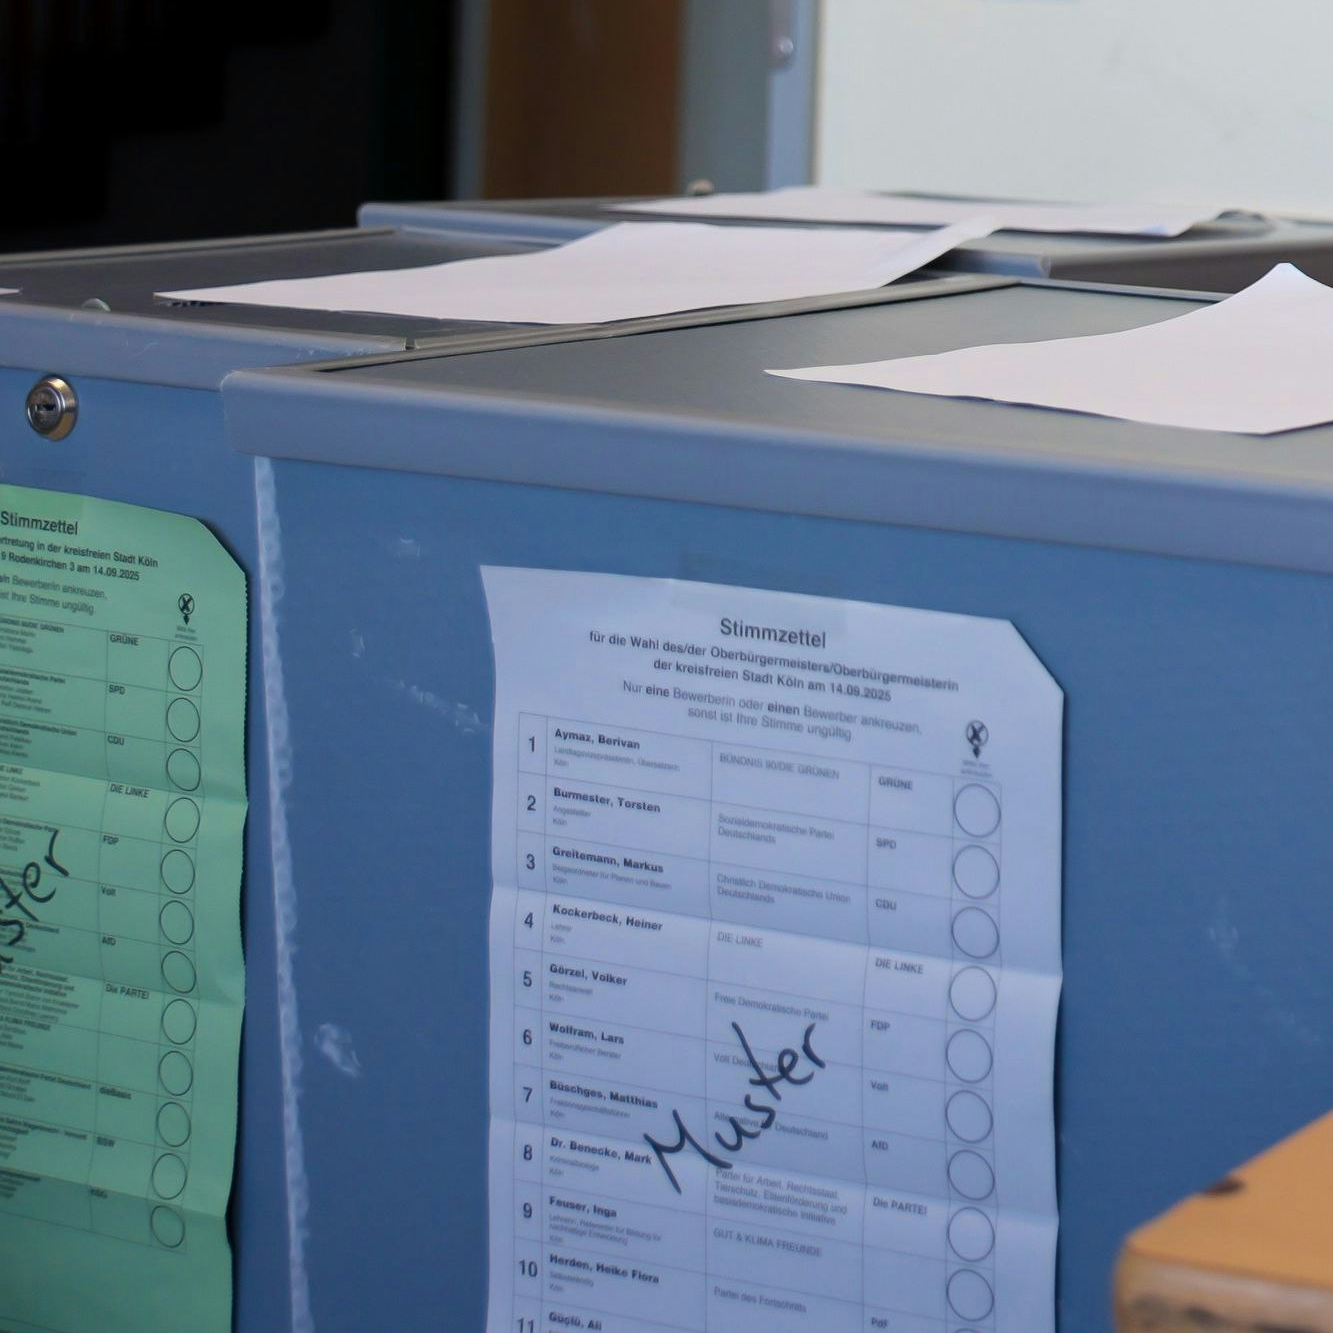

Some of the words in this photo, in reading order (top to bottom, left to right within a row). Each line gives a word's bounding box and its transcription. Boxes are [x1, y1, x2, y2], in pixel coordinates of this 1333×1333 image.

[1, 511, 78, 535] Stimmzettel
[37, 542, 45, 551] in
[47, 543, 61, 553] der
[64, 545, 111, 560] kreisfreien
[114, 551, 135, 564] Stadt
[139, 555, 158, 568] Köln
[9, 552, 66, 570] Rodenkirchen
[70, 561, 74, 571] 3
[78, 564, 90, 574] am
[94, 566, 140, 581] 14.09.2025
[29, 594, 60, 608] Stimme
[720, 617, 827, 649] Stimmzettel
[589, 630, 605, 644] für
[608, 634, 626, 647] die
[630, 636, 660, 650] Wahl
[662, 640, 707, 657] des/der
[710, 646, 959, 692] Oberbürgermeisters/Oberbürgermeisterin
[653, 658, 672, 672] der
[676, 660, 739, 681] kreisfreien
[742, 669, 773, 685] Stadt
[777, 672, 804, 689] Köln
[808, 680, 826, 693] am
[830, 682, 892, 702] 14.09.2025
[109, 684, 125, 695] SPD
[623, 680, 642, 694] Nur
[645, 685, 670, 698] eine
[673, 687, 736, 707] Bewerberin
[739, 696, 764, 711] oder
[767, 701, 800, 715] einen
[803, 705, 858, 725] Bewerber
[688, 707, 717, 721] sonst
[720, 711, 733, 723] ist
[736, 712, 758, 727] Ihre
[761, 715, 804, 733] Stimme
[807, 722, 851, 743] ungültig
[107, 735, 125, 746] CDU
[528, 736, 535, 752] 1
[555, 729, 594, 745] Aymaz,
[598, 734, 640, 750] Berivan
[110, 783, 123, 795] DIE
[125, 785, 150, 798] LINKE
[878, 776, 913, 791] GRÜNE
[527, 795, 536, 811] 2
[553, 787, 614, 808] Burmester,
[618, 797, 661, 813] Torsten
[876, 838, 896, 850] SPD
[526, 853, 535, 870] 3
[552, 846, 620, 867] Greitemann,
[623, 858, 663, 873] Markus
[875, 898, 897, 911] CDU
[524, 912, 534, 929] 4
[553, 904, 622, 926] Kockerbeck,
[626, 917, 662, 931] Heiner
[717, 931, 733, 944] DIE
[736, 935, 764, 948] LINKE
[550, 963, 588, 980] Görzel,
[592, 970, 628, 985] Volker
[875, 957, 892, 970] DIE
[894, 961, 924, 975] LINKE
[523, 970, 532, 988] 5
[715, 992, 736, 1004] Freie
[549, 1022, 597, 1041] Wolfram,
[601, 1031, 624, 1045] Lars
[870, 1020, 890, 1031] FDP
[523, 1029, 532, 1045] 6
[522, 1086, 533, 1103] 7
[550, 1080, 607, 1101] Büschges,
[610, 1091, 658, 1109] Matthias
[871, 1081, 889, 1092] Volt
[643, 1022, 826, 1195] Muster
[523, 1144, 533, 1161] 8
[551, 1137, 566, 1149] Dr.
[570, 1140, 621, 1160] Benecke,
[625, 1150, 652, 1165] Mark
[871, 1139, 889, 1151] AfD
[523, 1202, 533, 1218] 9
[549, 1196, 590, 1214] Feuser,
[593, 1204, 617, 1218] Inga
[873, 1196, 889, 1208] Die
[891, 1199, 927, 1216] PARTEI
[713, 1228, 734, 1240] GUT
[744, 1234, 773, 1248] KLIMA
[776, 1240, 822, 1257] FREUNDE
[519, 1260, 538, 1277] 10
[550, 1254, 593, 1273] Herden,
[596, 1263, 628, 1278] Heike
[632, 1270, 659, 1284] Flora
[714, 1286, 739, 1300] Partei
[517, 1318, 535, 1333] 11
